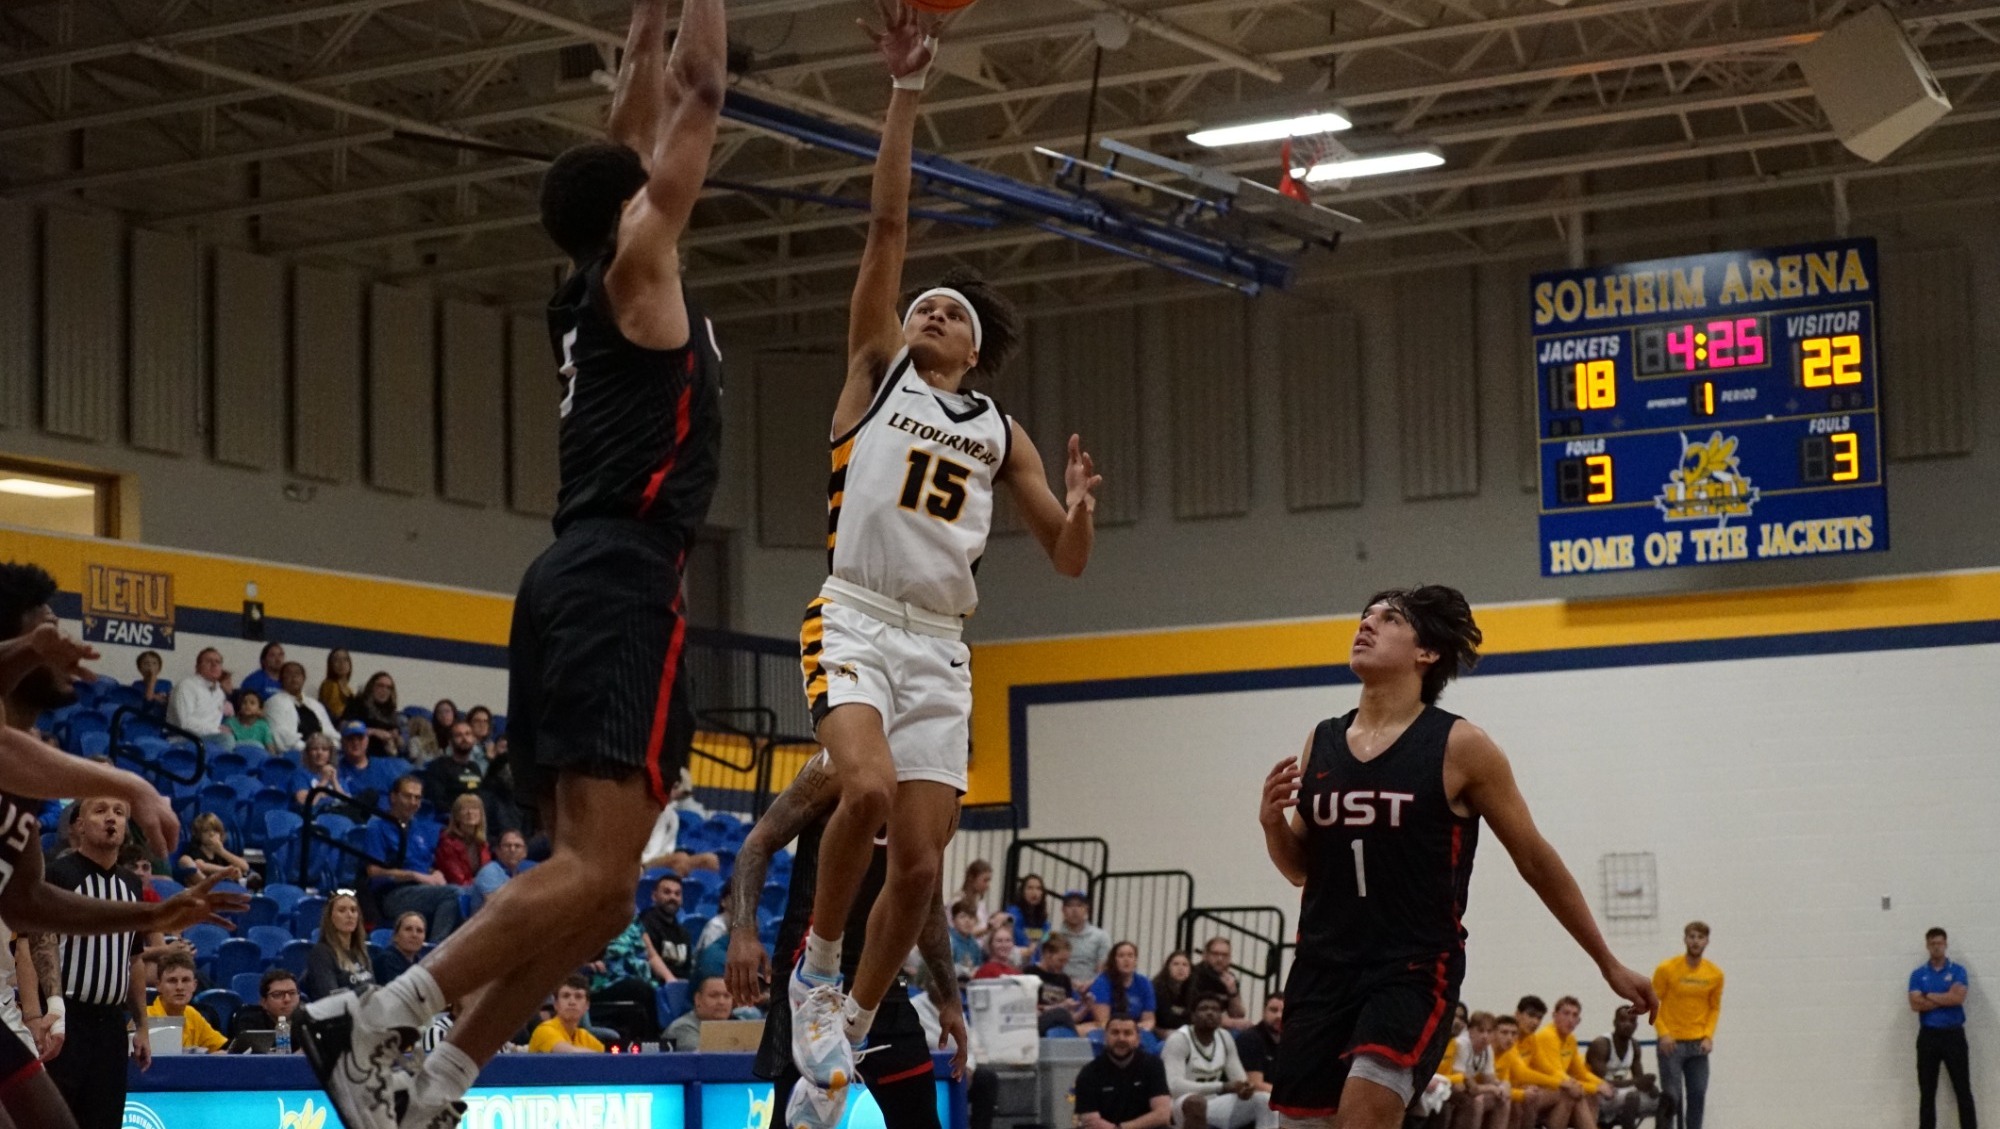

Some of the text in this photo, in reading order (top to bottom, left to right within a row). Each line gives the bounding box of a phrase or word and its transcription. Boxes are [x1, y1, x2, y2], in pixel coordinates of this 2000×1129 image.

[1535, 248, 1869, 325] SOLHEIM ARENA
[1667, 318, 1764, 371] 4:25
[1787, 311, 1860, 338] VISITOR
[1540, 335, 1619, 363] JACKETS
[1802, 335, 1862, 388] 22
[1575, 360, 1615, 410] 18
[1704, 382, 1713, 414] 1
[1721, 388, 1757, 402] PERIOD
[1565, 439, 1606, 456] FOULS
[1809, 416, 1850, 434] FOULS
[1585, 455, 1613, 503] 3
[1831, 433, 1859, 481] 3
[898, 445, 973, 523] 15
[1550, 516, 1874, 573] HOME OF THE JACKETS
[89, 564, 169, 620] LETU
[104, 619, 154, 646] FANS
[0, 794, 36, 852] US
[1313, 790, 1415, 828] UST
[1350, 838, 1367, 897] 1
[459, 1093, 653, 1129] TOURNEAU
